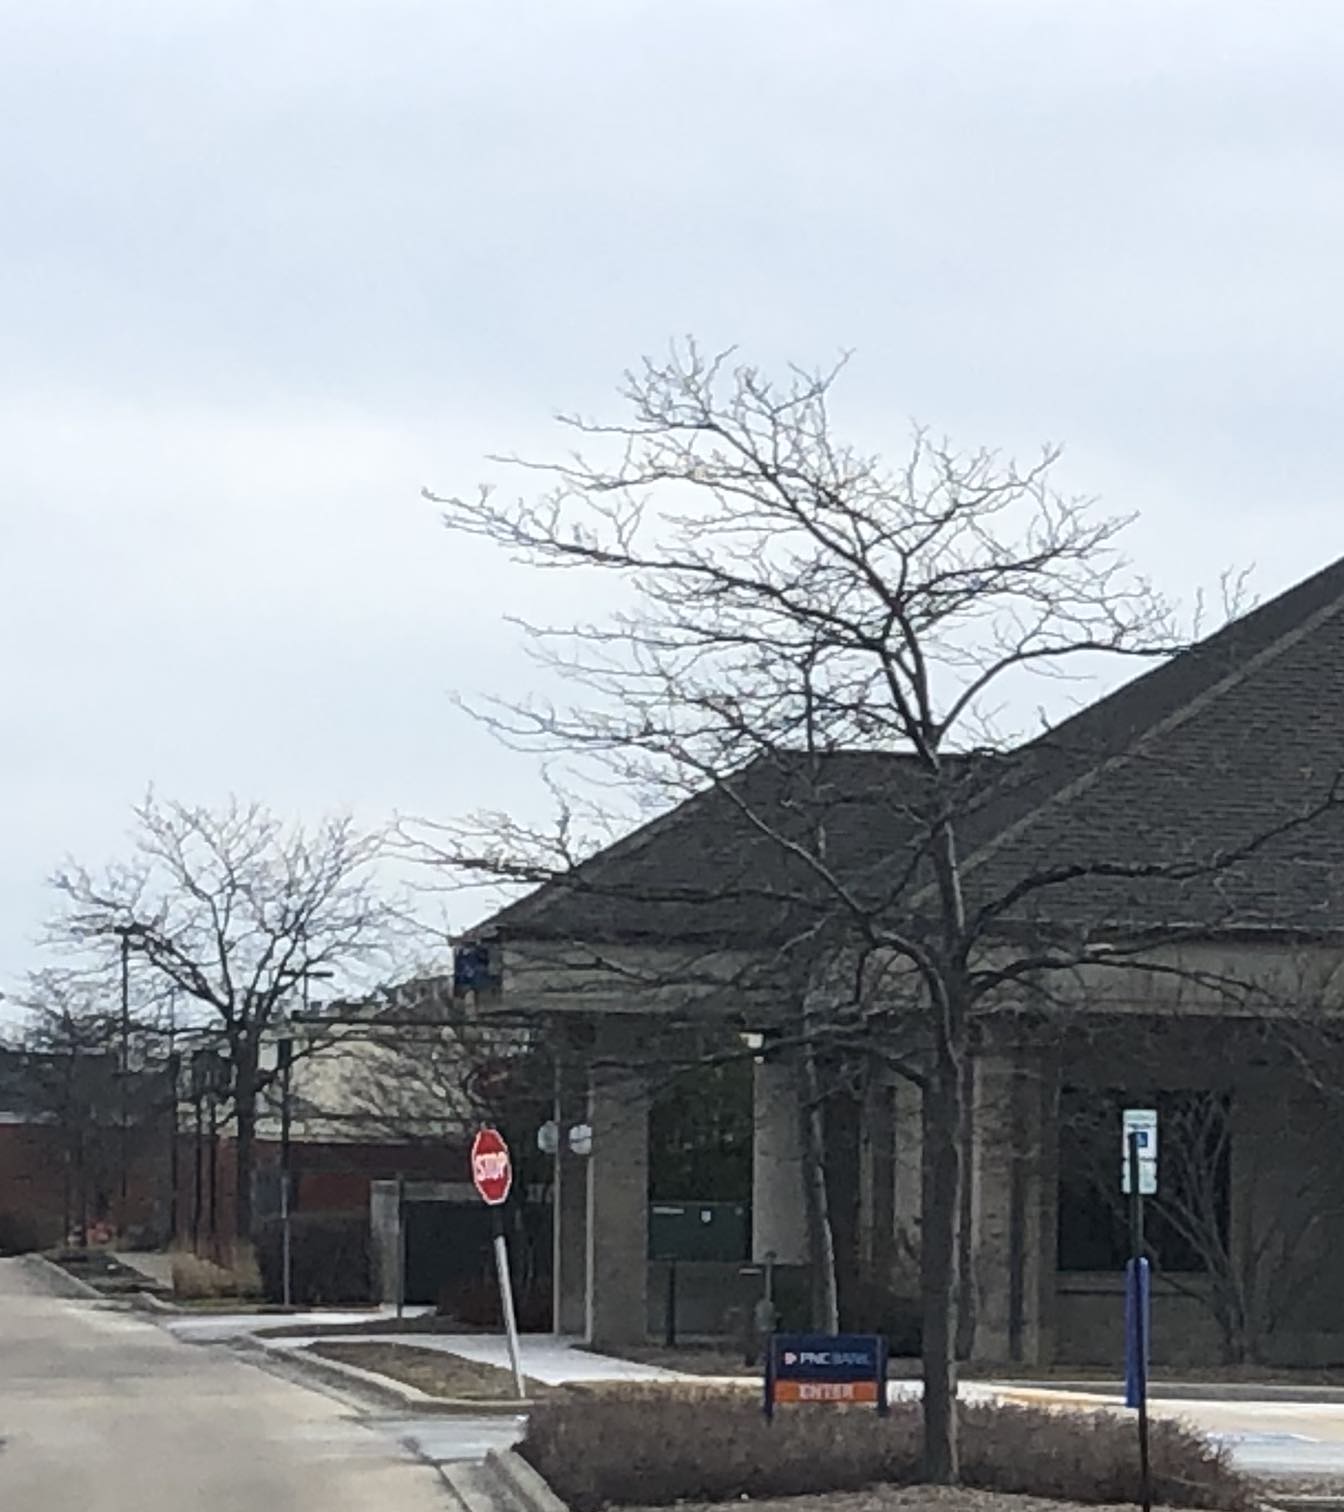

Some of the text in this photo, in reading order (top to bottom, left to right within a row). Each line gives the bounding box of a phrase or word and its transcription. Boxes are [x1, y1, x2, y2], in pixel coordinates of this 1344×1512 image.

[476, 1152, 508, 1181] STOP
[800, 1352, 830, 1365] PNC
[799, 1384, 853, 1400] ENTER
